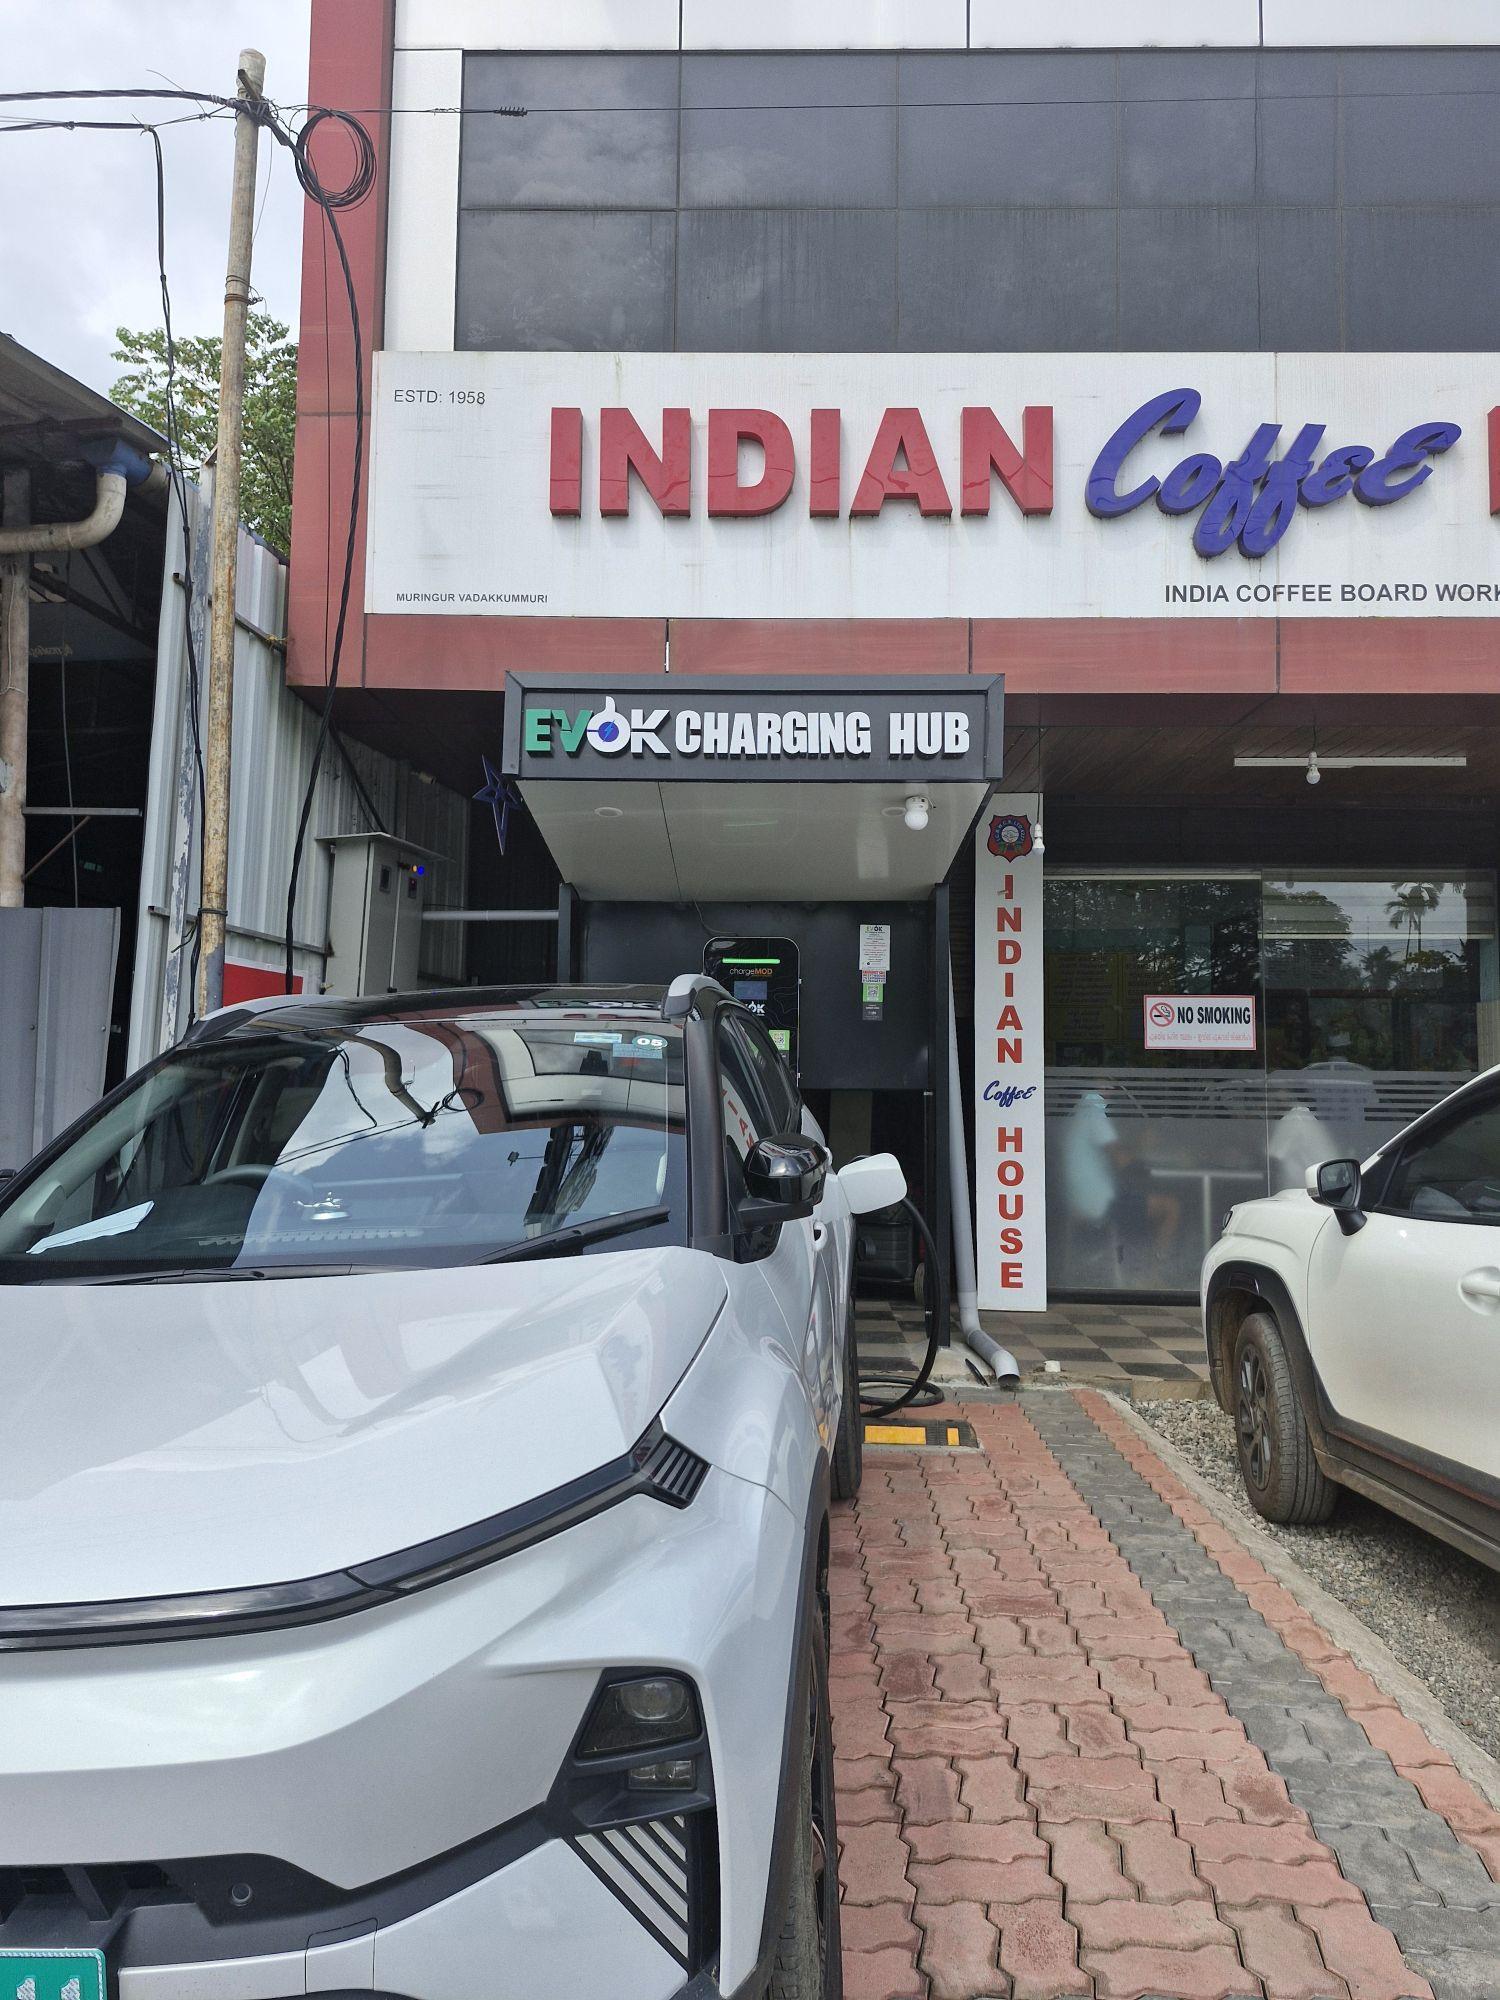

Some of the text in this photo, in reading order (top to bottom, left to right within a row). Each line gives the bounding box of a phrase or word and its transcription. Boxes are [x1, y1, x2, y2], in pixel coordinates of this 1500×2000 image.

[394, 389, 486, 405] ESTD: 1958
[549, 406, 1053, 518] INDIAN
[1086, 388, 1462, 560] Coffee
[396, 593, 548, 603] MURINGUR VADAKKUMMURI
[1165, 584, 1231, 603] INDIA
[1236, 584, 1332, 603] COFFEE
[1340, 583, 1428, 602] BOARD
[524, 696, 970, 756] EVOK CHARGING HUB
[996, 874, 1023, 1064] INDIAN
[1177, 1006, 1251, 1025] NO SMOKING
[636, 1037, 664, 1048] 05
[983, 1080, 1037, 1108] Coffee
[997, 1127, 1024, 1289] HOUSE
